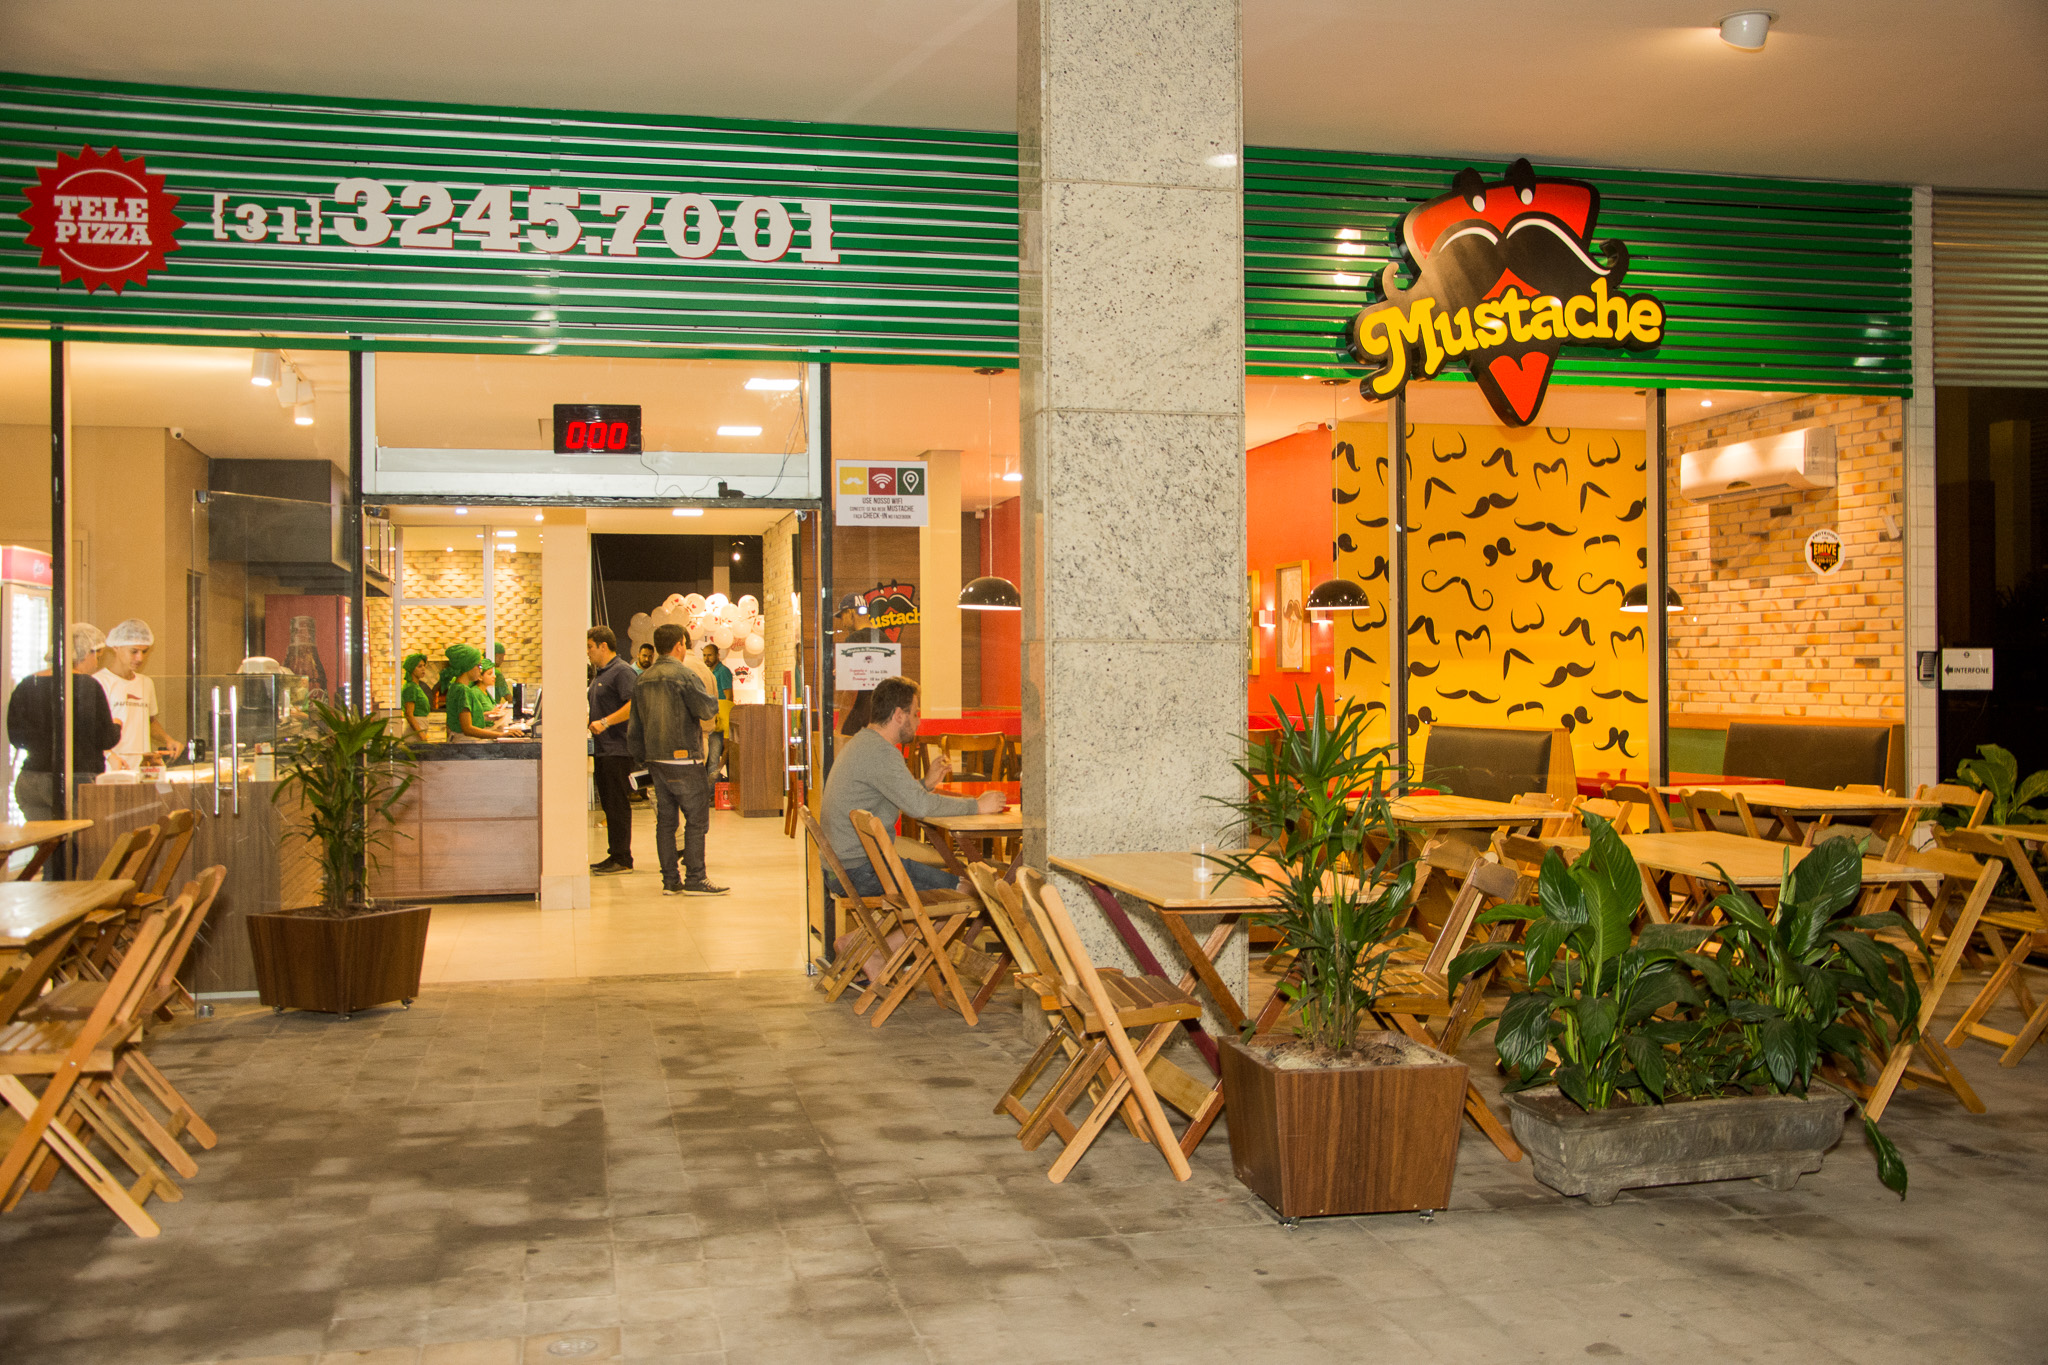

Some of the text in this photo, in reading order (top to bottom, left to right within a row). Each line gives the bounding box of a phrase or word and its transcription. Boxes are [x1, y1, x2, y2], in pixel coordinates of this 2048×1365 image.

[54, 195, 150, 223] TELE
[333, 177, 840, 263] 3245.7001
[54, 221, 152, 245] PIZZA
[1359, 277, 1663, 394] Mustache
[565, 421, 629, 450] 000
[1813, 543, 1838, 556] EMIVE
[868, 607, 921, 629] ustach
